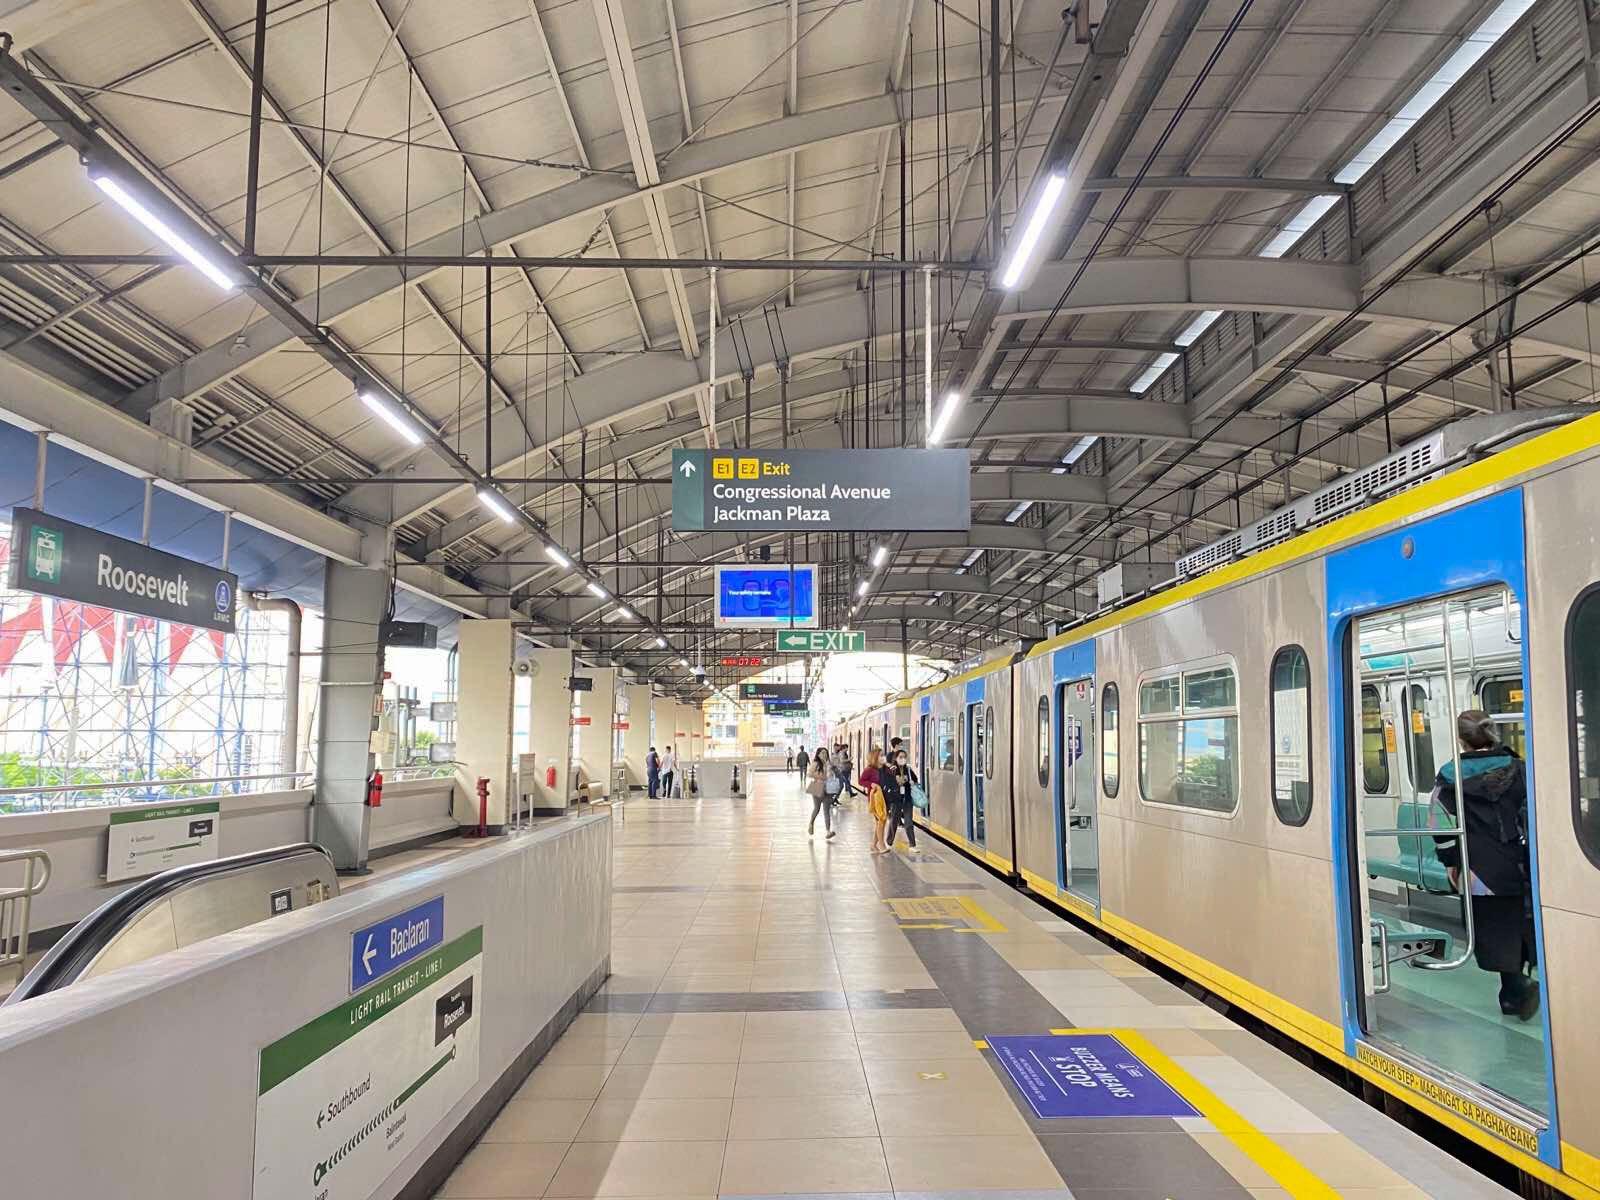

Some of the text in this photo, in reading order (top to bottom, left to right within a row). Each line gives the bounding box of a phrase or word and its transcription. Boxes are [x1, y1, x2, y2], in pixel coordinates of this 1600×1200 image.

[717, 462, 791, 476] E1 E2 Exit
[713, 483, 892, 503] Congressional Avenue
[713, 505, 832, 524] Jackman Plaza
[97, 553, 189, 607] Roosevelt
[810, 632, 858, 651] EXIT
[390, 918, 430, 959] Baclaran
[350, 998, 373, 1025] LIGHT
[375, 990, 391, 1009] RAIL
[393, 971, 420, 998] TRANSIT
[425, 960, 439, 978] LINE
[443, 1000, 466, 1029] Roosevelt
[1055, 1063, 1098, 1088] STOP
[1070, 1047, 1108, 1072] BUZZER
[1094, 1072, 1136, 1098] MEANS
[327, 1072, 371, 1122] Southbound
[1359, 1047, 1379, 1069] WATCH
[1379, 1055, 1396, 1077] YOUR
[1396, 1065, 1415, 1087] STEP
[1419, 1078, 1462, 1112] MAG-INGAT
[1462, 1101, 1474, 1119] SA
[1475, 1108, 1538, 1152] PAGHAKBANG
